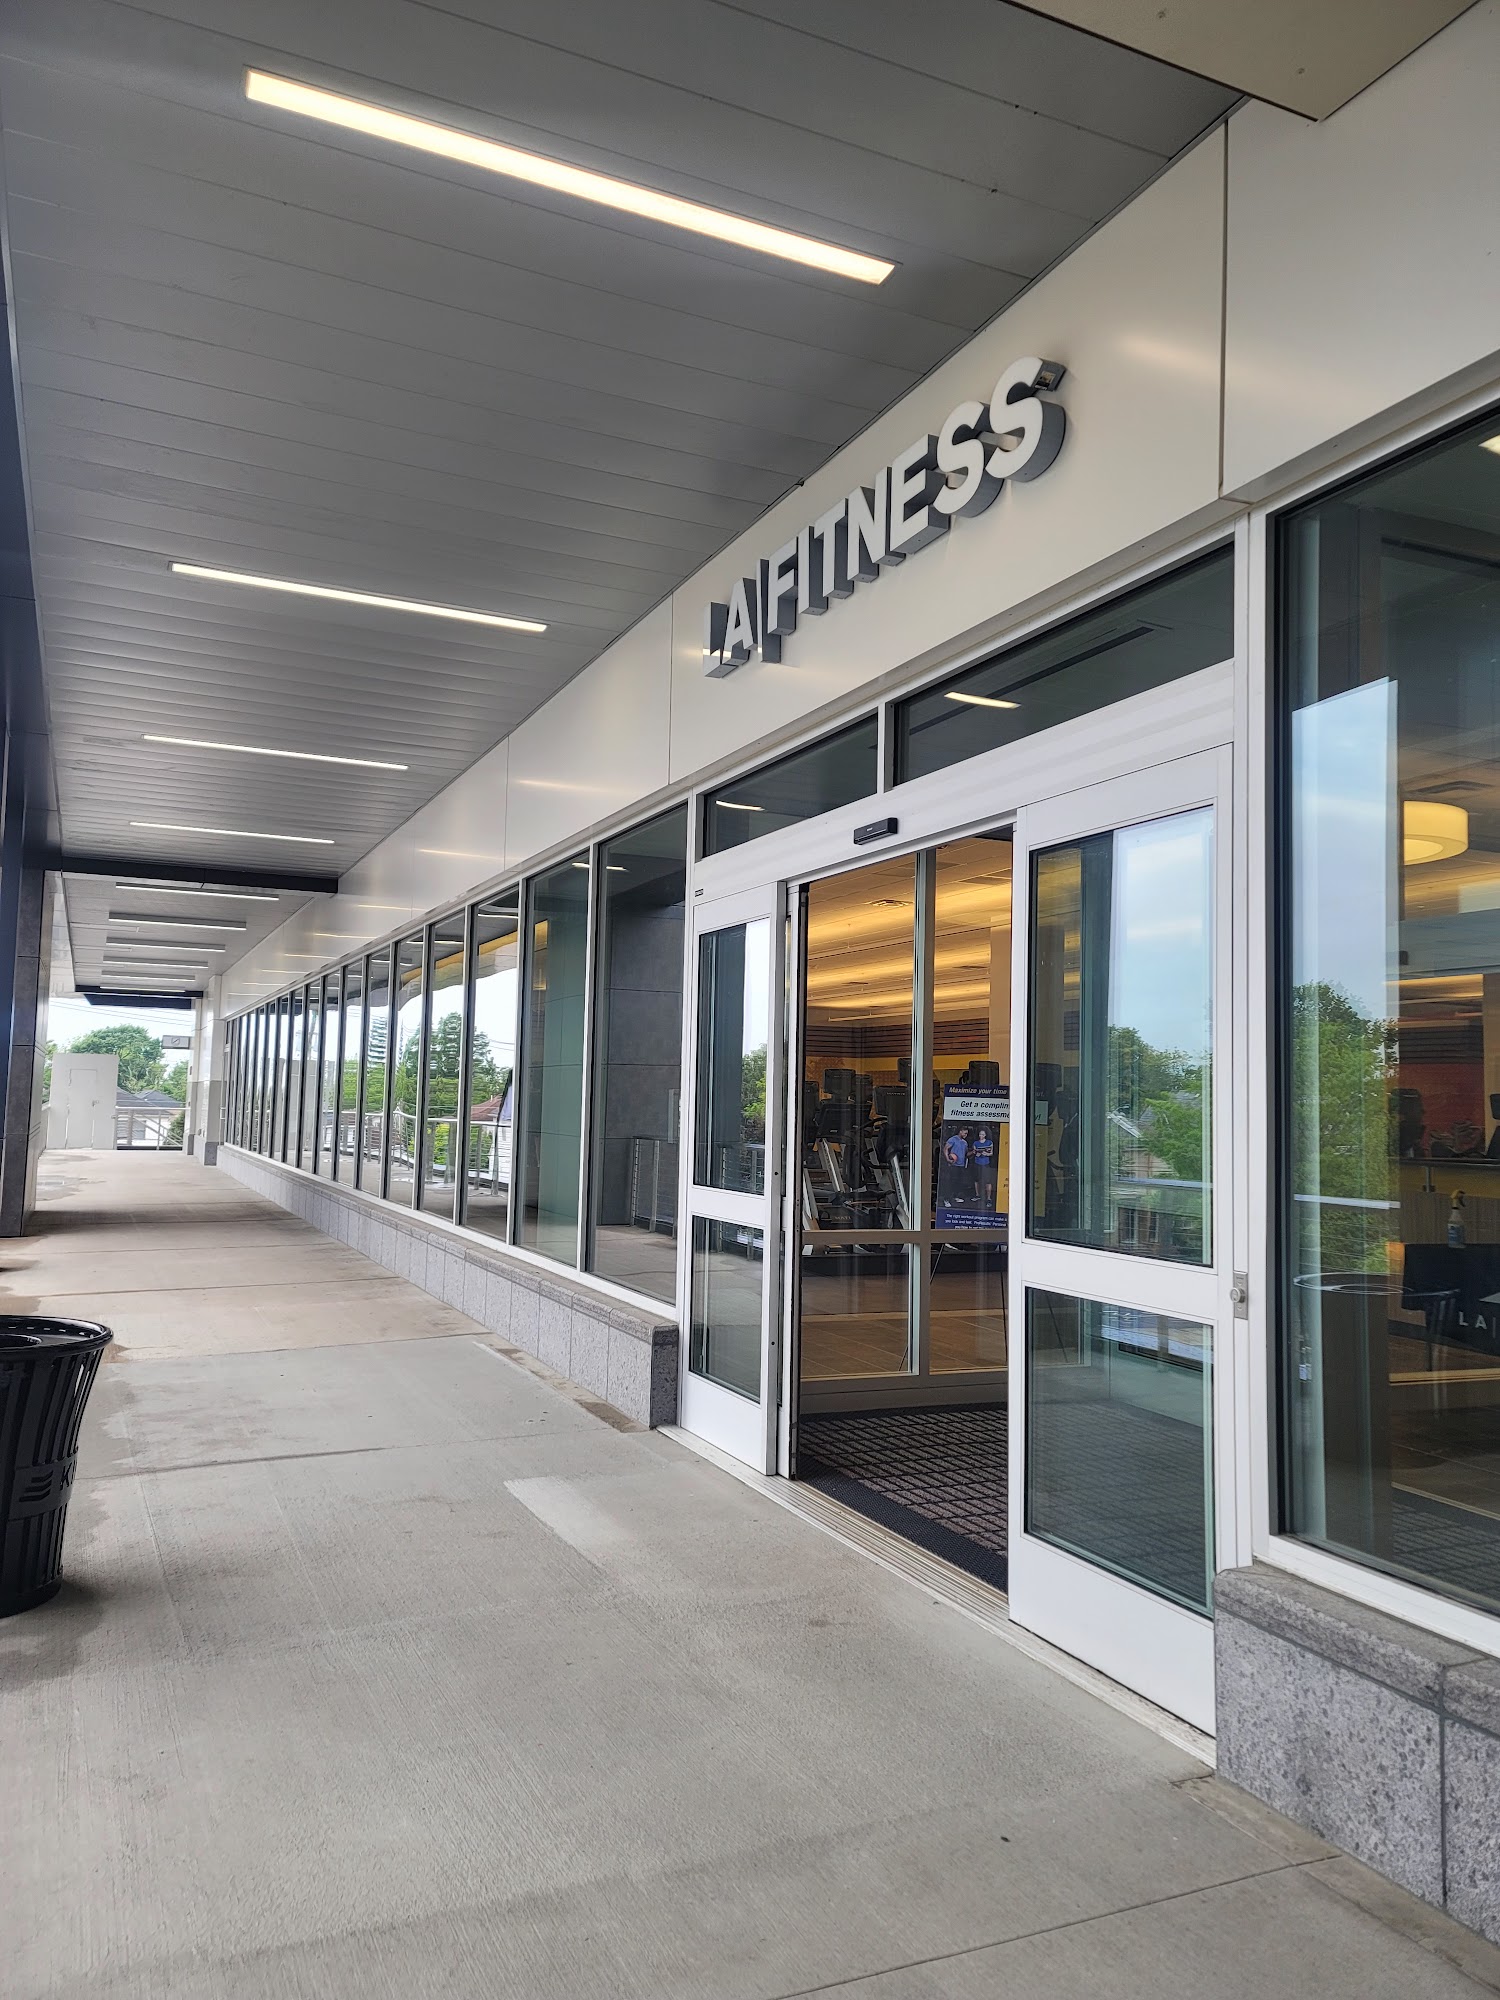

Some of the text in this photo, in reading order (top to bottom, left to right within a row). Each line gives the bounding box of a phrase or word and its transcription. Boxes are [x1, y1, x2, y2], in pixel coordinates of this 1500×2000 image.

[703, 356, 1066, 678] LA FITNESS
[960, 1100, 972, 1108] Get
[950, 1109, 975, 1117] fitness
[1458, 1311, 1488, 1330] LA
